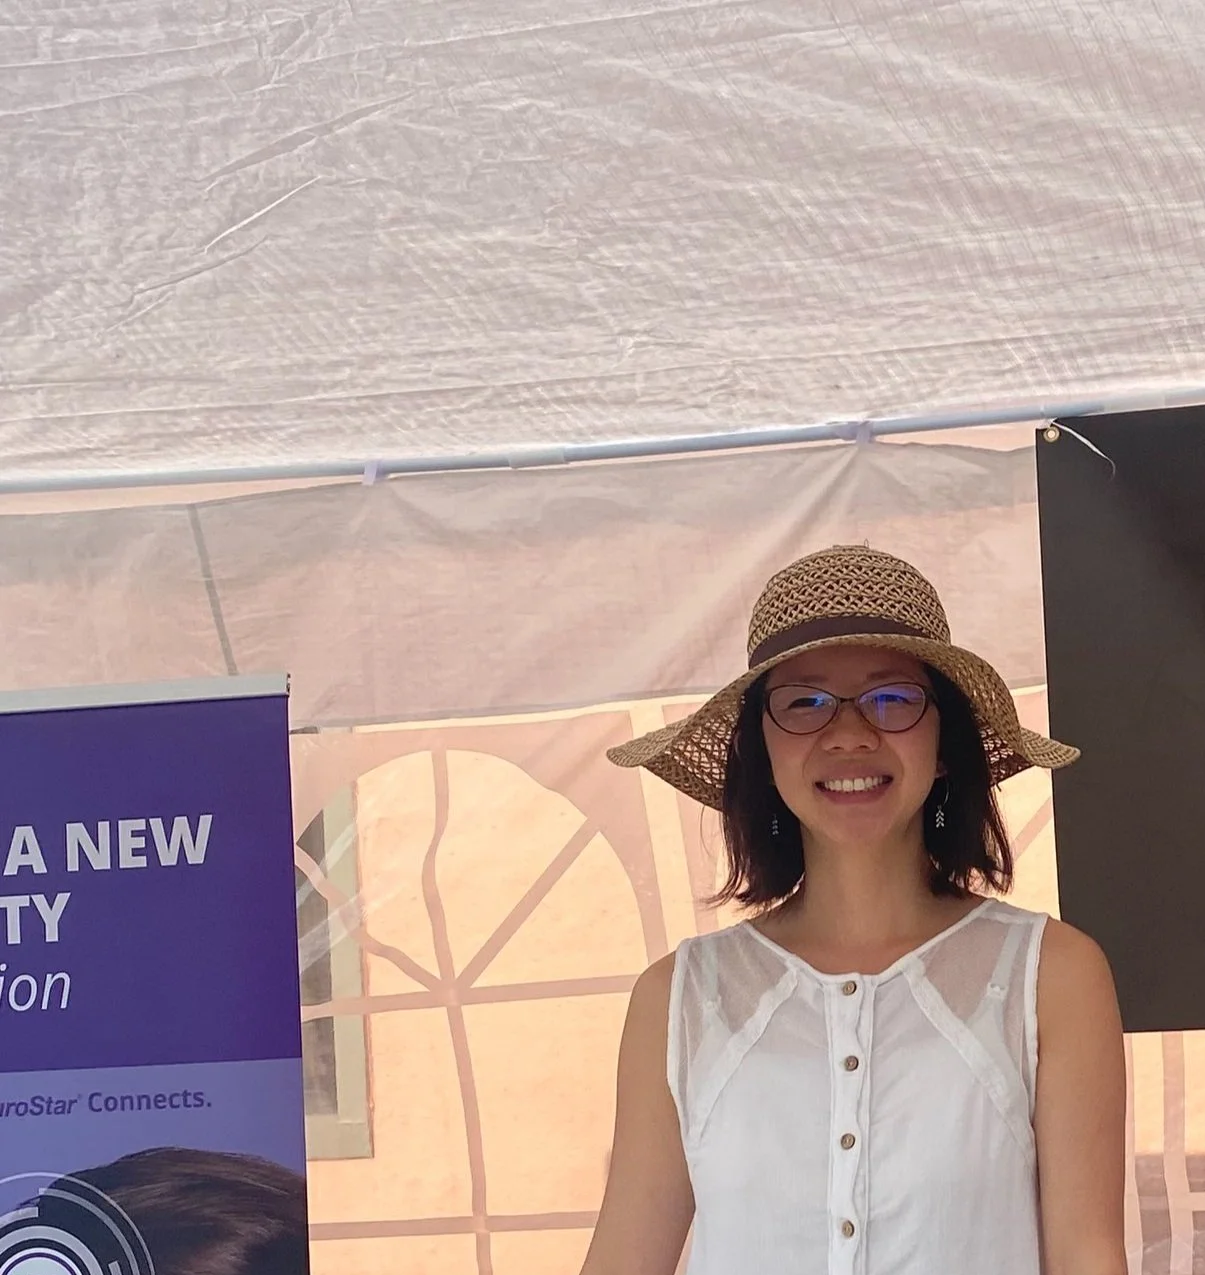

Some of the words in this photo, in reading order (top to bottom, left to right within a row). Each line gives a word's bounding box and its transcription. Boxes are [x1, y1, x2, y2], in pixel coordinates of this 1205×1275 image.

[3, 825, 48, 876] A
[65, 814, 213, 872] NEW
[88, 1089, 212, 1114] Connects.
